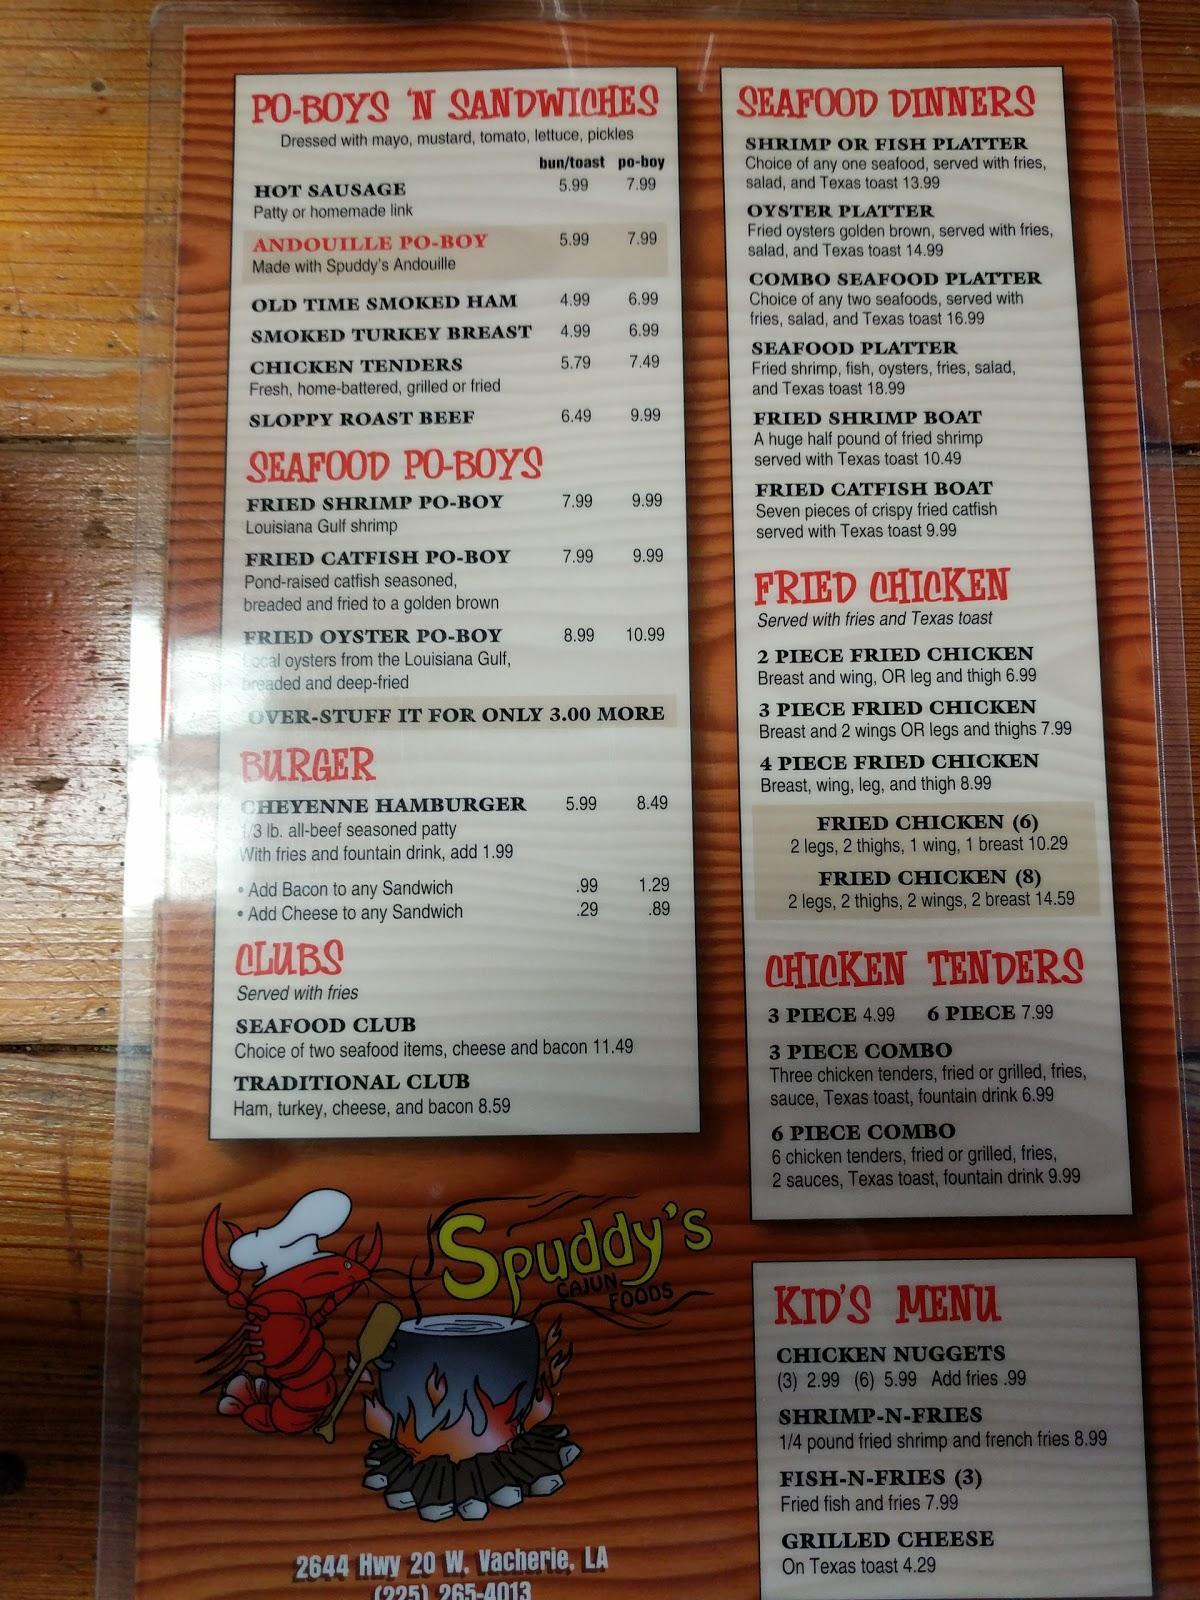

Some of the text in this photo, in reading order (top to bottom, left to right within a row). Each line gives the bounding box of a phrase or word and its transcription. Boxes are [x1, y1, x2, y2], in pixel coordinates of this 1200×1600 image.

[252, 85, 658, 124] PO-BOYS 'N SANDWICHES
[737, 85, 1035, 119] SEAFOOD DINNERS
[281, 127, 633, 149] Dressed with mayo, mustard, tomato, lettuce, pickles
[746, 137, 1028, 151] SHRIMP OR FISH PLATTER
[540, 155, 664, 170] bun/toast po-boy
[255, 177, 656, 198] HOT SAUSAGE 5.99 7.99
[254, 203, 413, 222] Patty or homemade link
[747, 205, 934, 217] OYSTER PLATTER
[254, 229, 658, 252] ANDOUILLE PO-BOY 5.99 7.99
[253, 257, 455, 275] Made with Spuddy's Andouille
[749, 272, 1042, 286] COMBO SEAFOOD PLATTER
[751, 311, 984, 327] fries, salad, and Texas toast 16.99
[752, 341, 957, 355] SEAFOOD PLATTER
[249, 408, 660, 427] SLOPPY ROAST BEEF 6.49 9.99
[754, 410, 982, 425] FRIED SHRIMP BOAT
[246, 446, 542, 483] SEAFOOD PO-BOYS
[247, 493, 662, 512] FRIED SHRIMP PO-BOY 7.99 9.99
[246, 518, 397, 535] Louisiana Gulf shrimp
[755, 567, 1011, 606] FRIED CHICKEN
[758, 611, 992, 627] Served with fries and Texas toast
[758, 647, 1033, 663] 2 PIECE FRIED CHICKEN
[240, 747, 376, 783] BURGER
[242, 795, 667, 814] CHEYENNE HAMBURGER 5.99 8.49
[816, 814, 1038, 833] FRIED CHICKEN (6)
[236, 939, 343, 976] CLUBS
[766, 948, 1083, 989] CHICKEN TENDERS
[237, 985, 358, 1001] Served with fries
[236, 1017, 416, 1034] SEAFOOD CLUB
[235, 1038, 633, 1059] Choice of two seafood items, cheese and bacon 11.49
[770, 1042, 952, 1060] 3 PIECE COMBO
[772, 1123, 955, 1141] 6 PIECE COMBO
[438, 1201, 715, 1314] Spuddy's
[556, 1273, 618, 1300] CAJUN
[609, 1281, 674, 1311] FOODS
[774, 1284, 1001, 1325] KID'S MENU
[777, 1345, 1005, 1363] CHICKEN NUGGETS
[778, 1370, 1026, 1392] (3) 2.99 (6) 5.99 Add fries .99
[779, 1407, 982, 1425] SHRIMP-N-FRIES
[780, 1430, 1107, 1454] 1/4 pound fried shrimp and french fries 8.99
[780, 1469, 982, 1490] FISH-N-FRIES (3)
[782, 1494, 958, 1512] Fried fish and fries 7.99
[782, 1531, 994, 1549] GRILLED CHEESE
[295, 1554, 349, 1579] 2644
[358, 1552, 401, 1577] Hwy
[409, 1550, 436, 1575] 20
[584, 1545, 609, 1569] LA
[783, 1557, 936, 1575] On Texas toast 4.29
